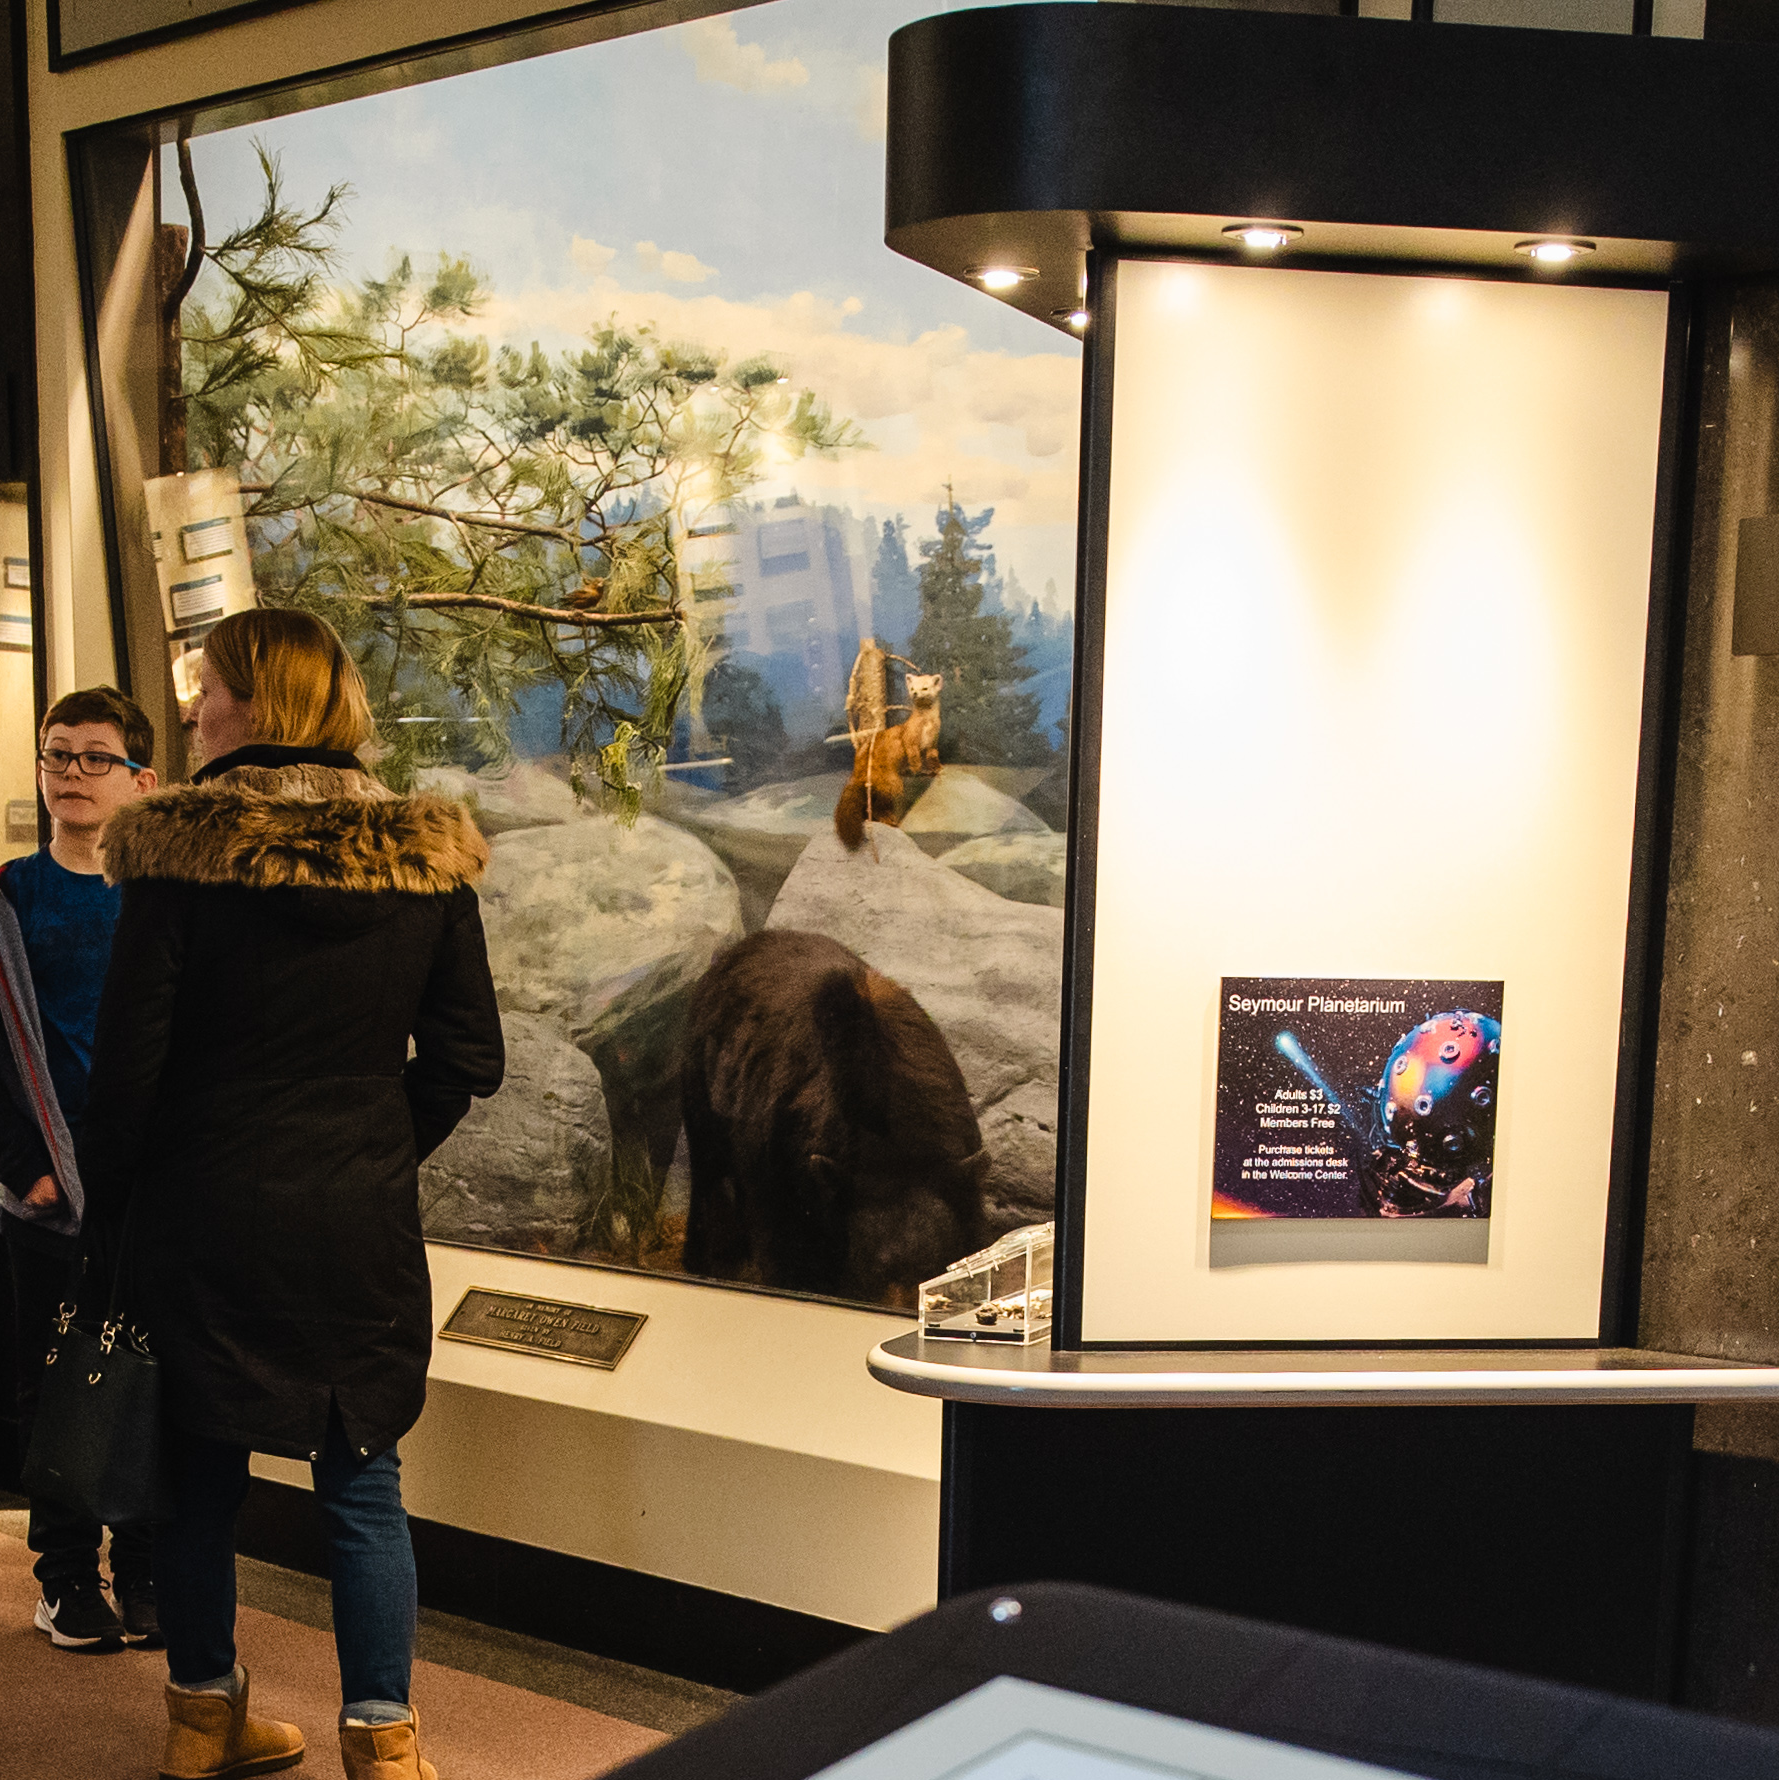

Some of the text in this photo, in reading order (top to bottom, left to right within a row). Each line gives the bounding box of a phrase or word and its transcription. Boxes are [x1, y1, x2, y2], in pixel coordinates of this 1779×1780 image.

[1228, 995, 1405, 1016] Seymour Planetarium
[1274, 1089, 1324, 1101] Adults $3
[1255, 1103, 1299, 1115] Children
[1327, 1103, 1341, 1116] $2
[1260, 1118, 1335, 1130] Members Free
[1258, 1145, 1335, 1156] Purchase tickets
[1243, 1157, 1348, 1168] at the admissions desk
[1242, 1169, 1349, 1181] in the Welcome Center.
[486, 1305, 601, 1335] MARGARET OWEN FIELD
[537, 1337, 563, 1349] FIELD
